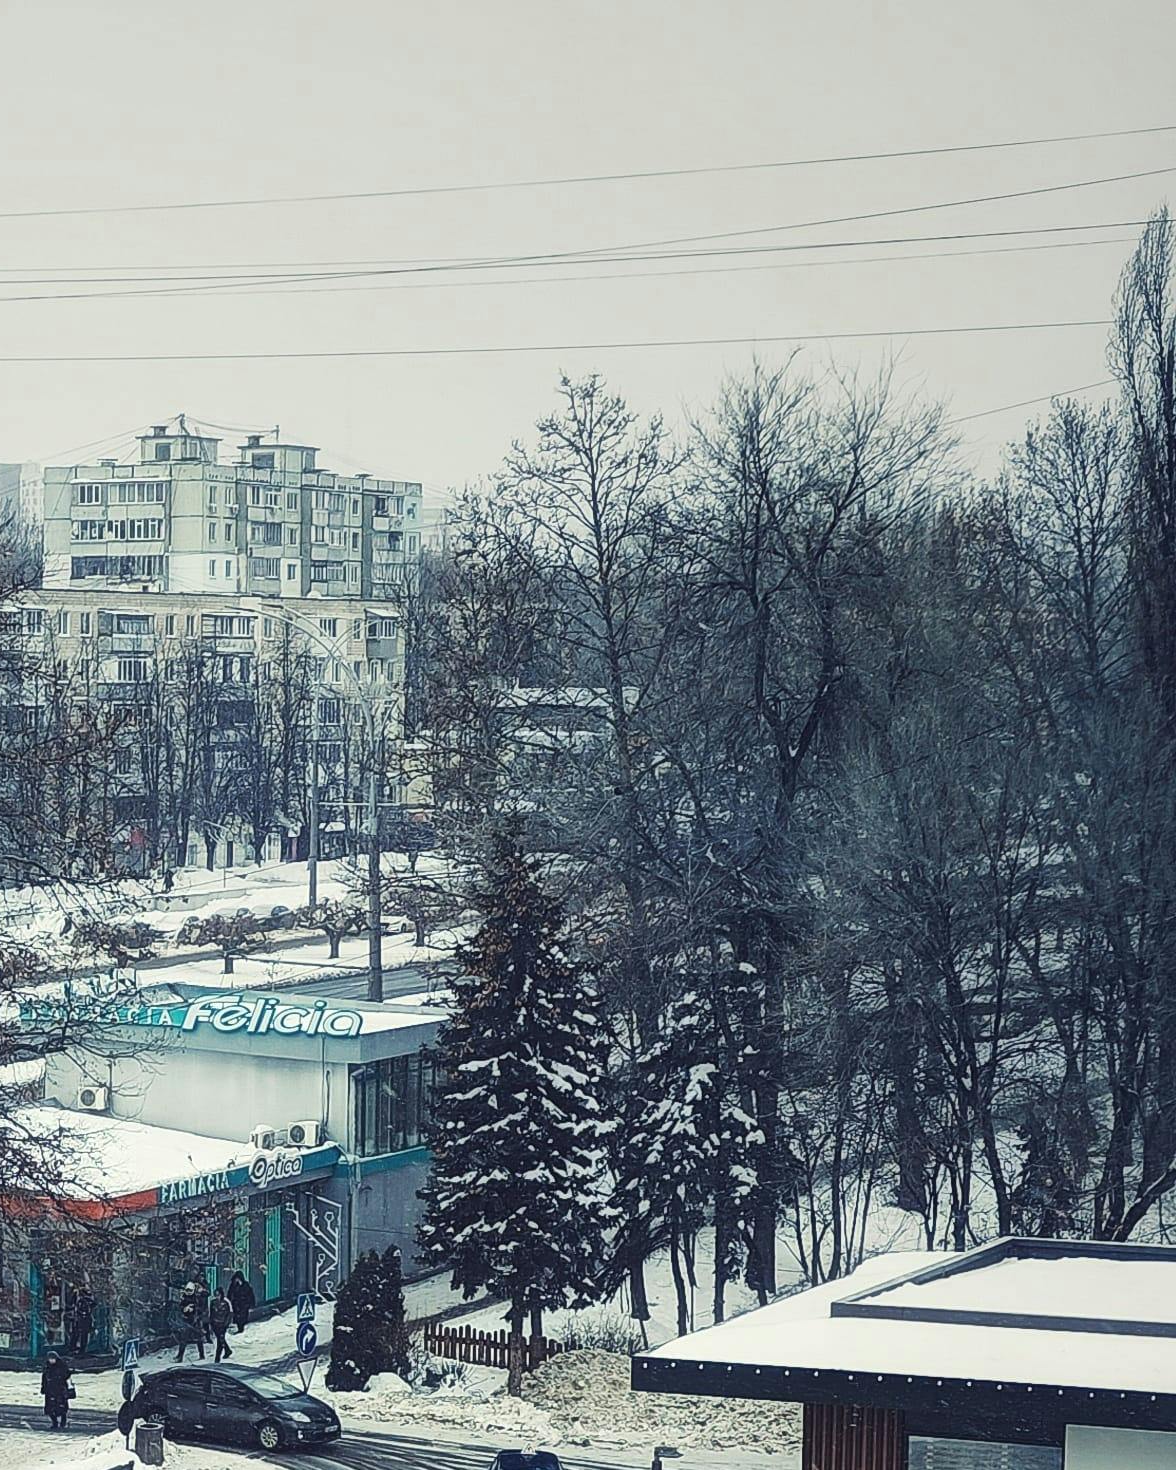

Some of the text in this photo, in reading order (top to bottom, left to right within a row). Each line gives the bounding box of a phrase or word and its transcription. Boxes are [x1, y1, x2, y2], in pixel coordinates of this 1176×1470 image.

[183, 991, 363, 1037] Felicia
[161, 1172, 229, 1202] FARMACIA
[250, 1152, 303, 1187] Optica
